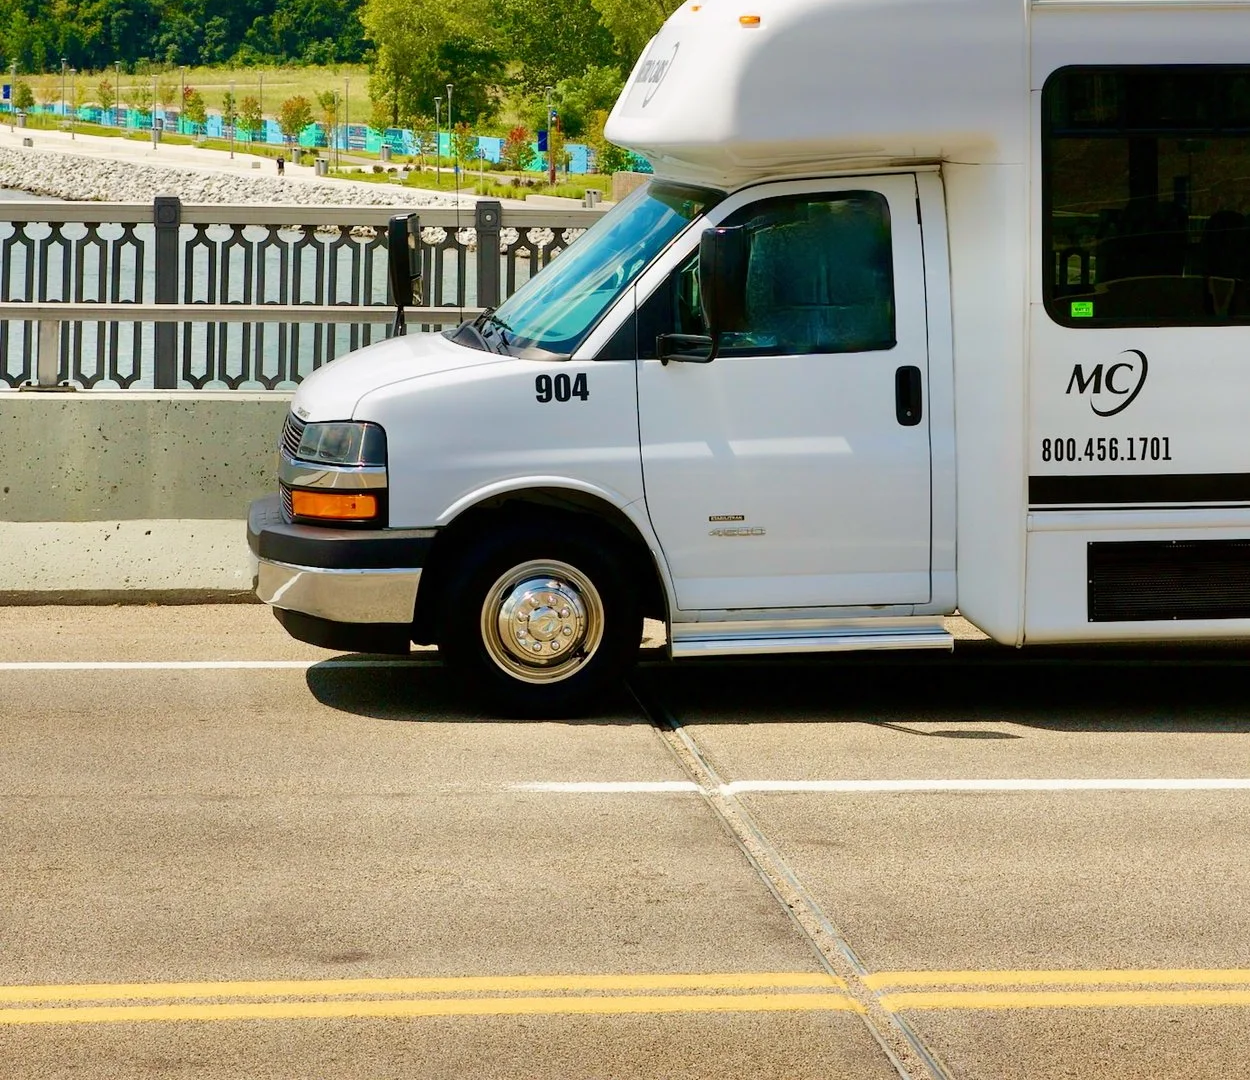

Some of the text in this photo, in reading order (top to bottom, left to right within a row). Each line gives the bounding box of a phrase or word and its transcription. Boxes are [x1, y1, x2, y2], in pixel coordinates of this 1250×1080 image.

[535, 373, 590, 404] 904
[1066, 362, 1134, 395] MC
[1042, 436, 1172, 462] 800.456.1701
